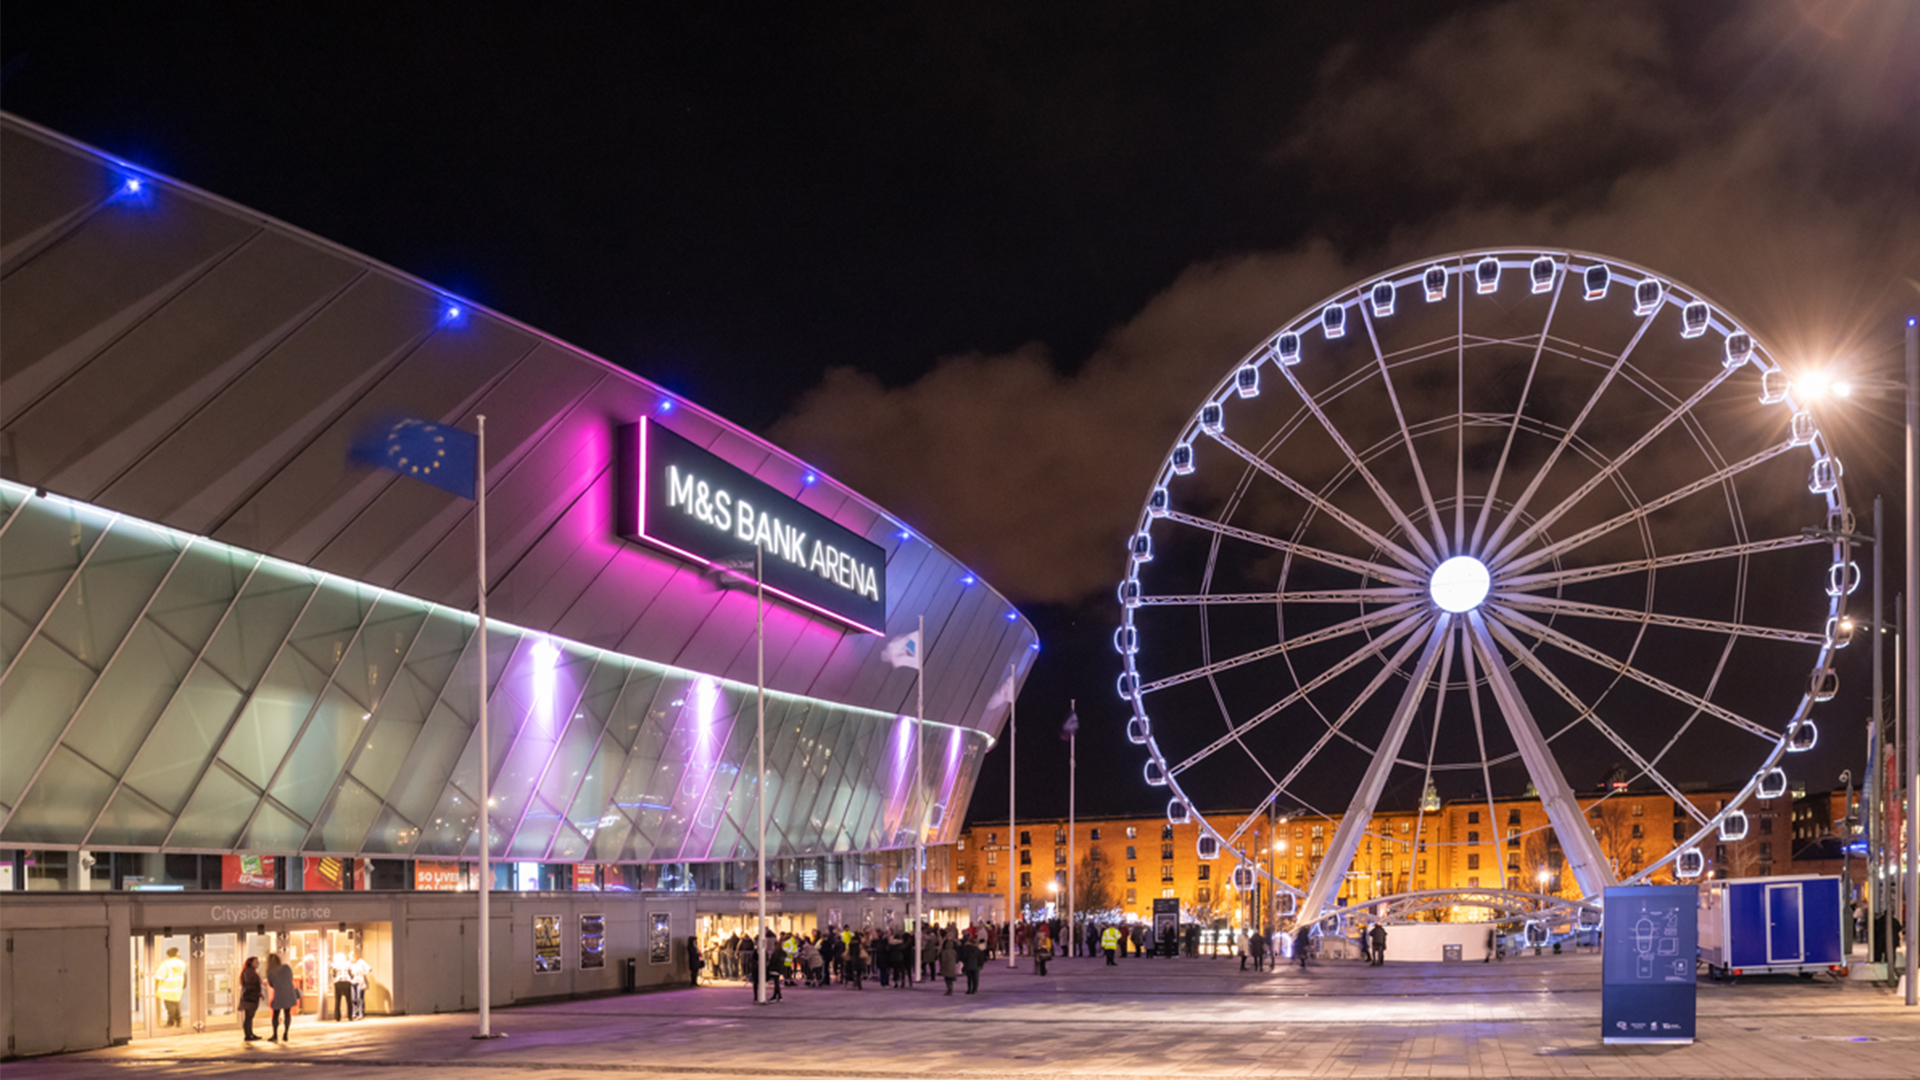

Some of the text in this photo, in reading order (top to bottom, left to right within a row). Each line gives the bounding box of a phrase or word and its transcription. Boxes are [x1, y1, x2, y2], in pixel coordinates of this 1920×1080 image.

[665, 464, 879, 601] M&S BANK ARENA
[418, 871, 433, 882] SO
[211, 904, 331, 923] Cityside Entrance
